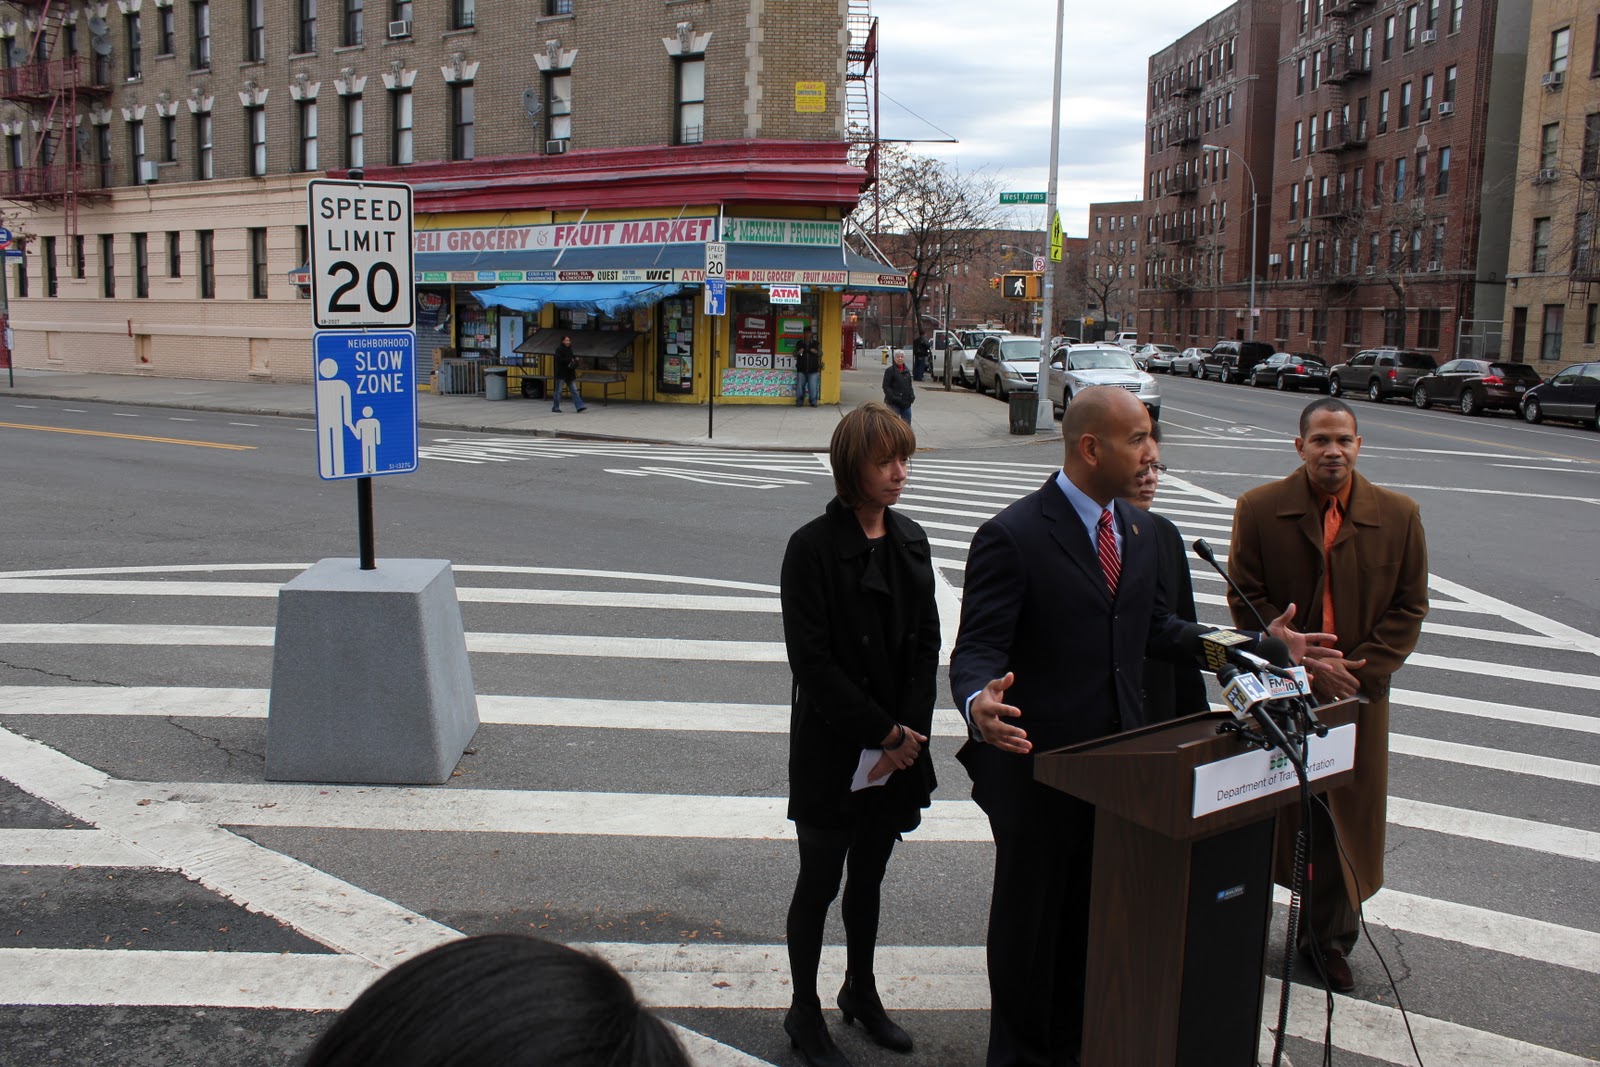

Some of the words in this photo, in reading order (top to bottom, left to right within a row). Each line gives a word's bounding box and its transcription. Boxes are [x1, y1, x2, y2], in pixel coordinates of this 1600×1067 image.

[320, 196, 402, 222] SPEED
[328, 229, 396, 252] LIMIT
[447, 228, 532, 251] GROCERY
[536, 230, 549, 246] &
[554, 224, 616, 246] FRUIT
[620, 220, 712, 244] MARKET
[739, 220, 786, 242] MEXICAN
[790, 222, 840, 244] PRODUCTS
[598, 271, 618, 280] QUEST
[646, 270, 670, 280] WIC
[708, 261, 724, 275] 20
[682, 271, 705, 280] ATM
[752, 271, 765, 282] DELI
[767, 271, 796, 282] GROCERY
[803, 272, 821, 282] FRUIT
[821, 272, 846, 283] MARKET
[327, 260, 400, 313] 20
[772, 289, 799, 298] ATM
[348, 338, 409, 348] NEIGHBORHOOD
[355, 350, 404, 371] SLOW
[357, 373, 404, 394] ZONE
[1203, 640, 1220, 670] 1010
[1241, 676, 1254, 684] NY
[1269, 678, 1285, 688] FM
[1227, 687, 1238, 700] NY
[1217, 778, 1267, 801] Department
[1268, 774, 1277, 786] of
[1280, 758, 1335, 782] Transortation
